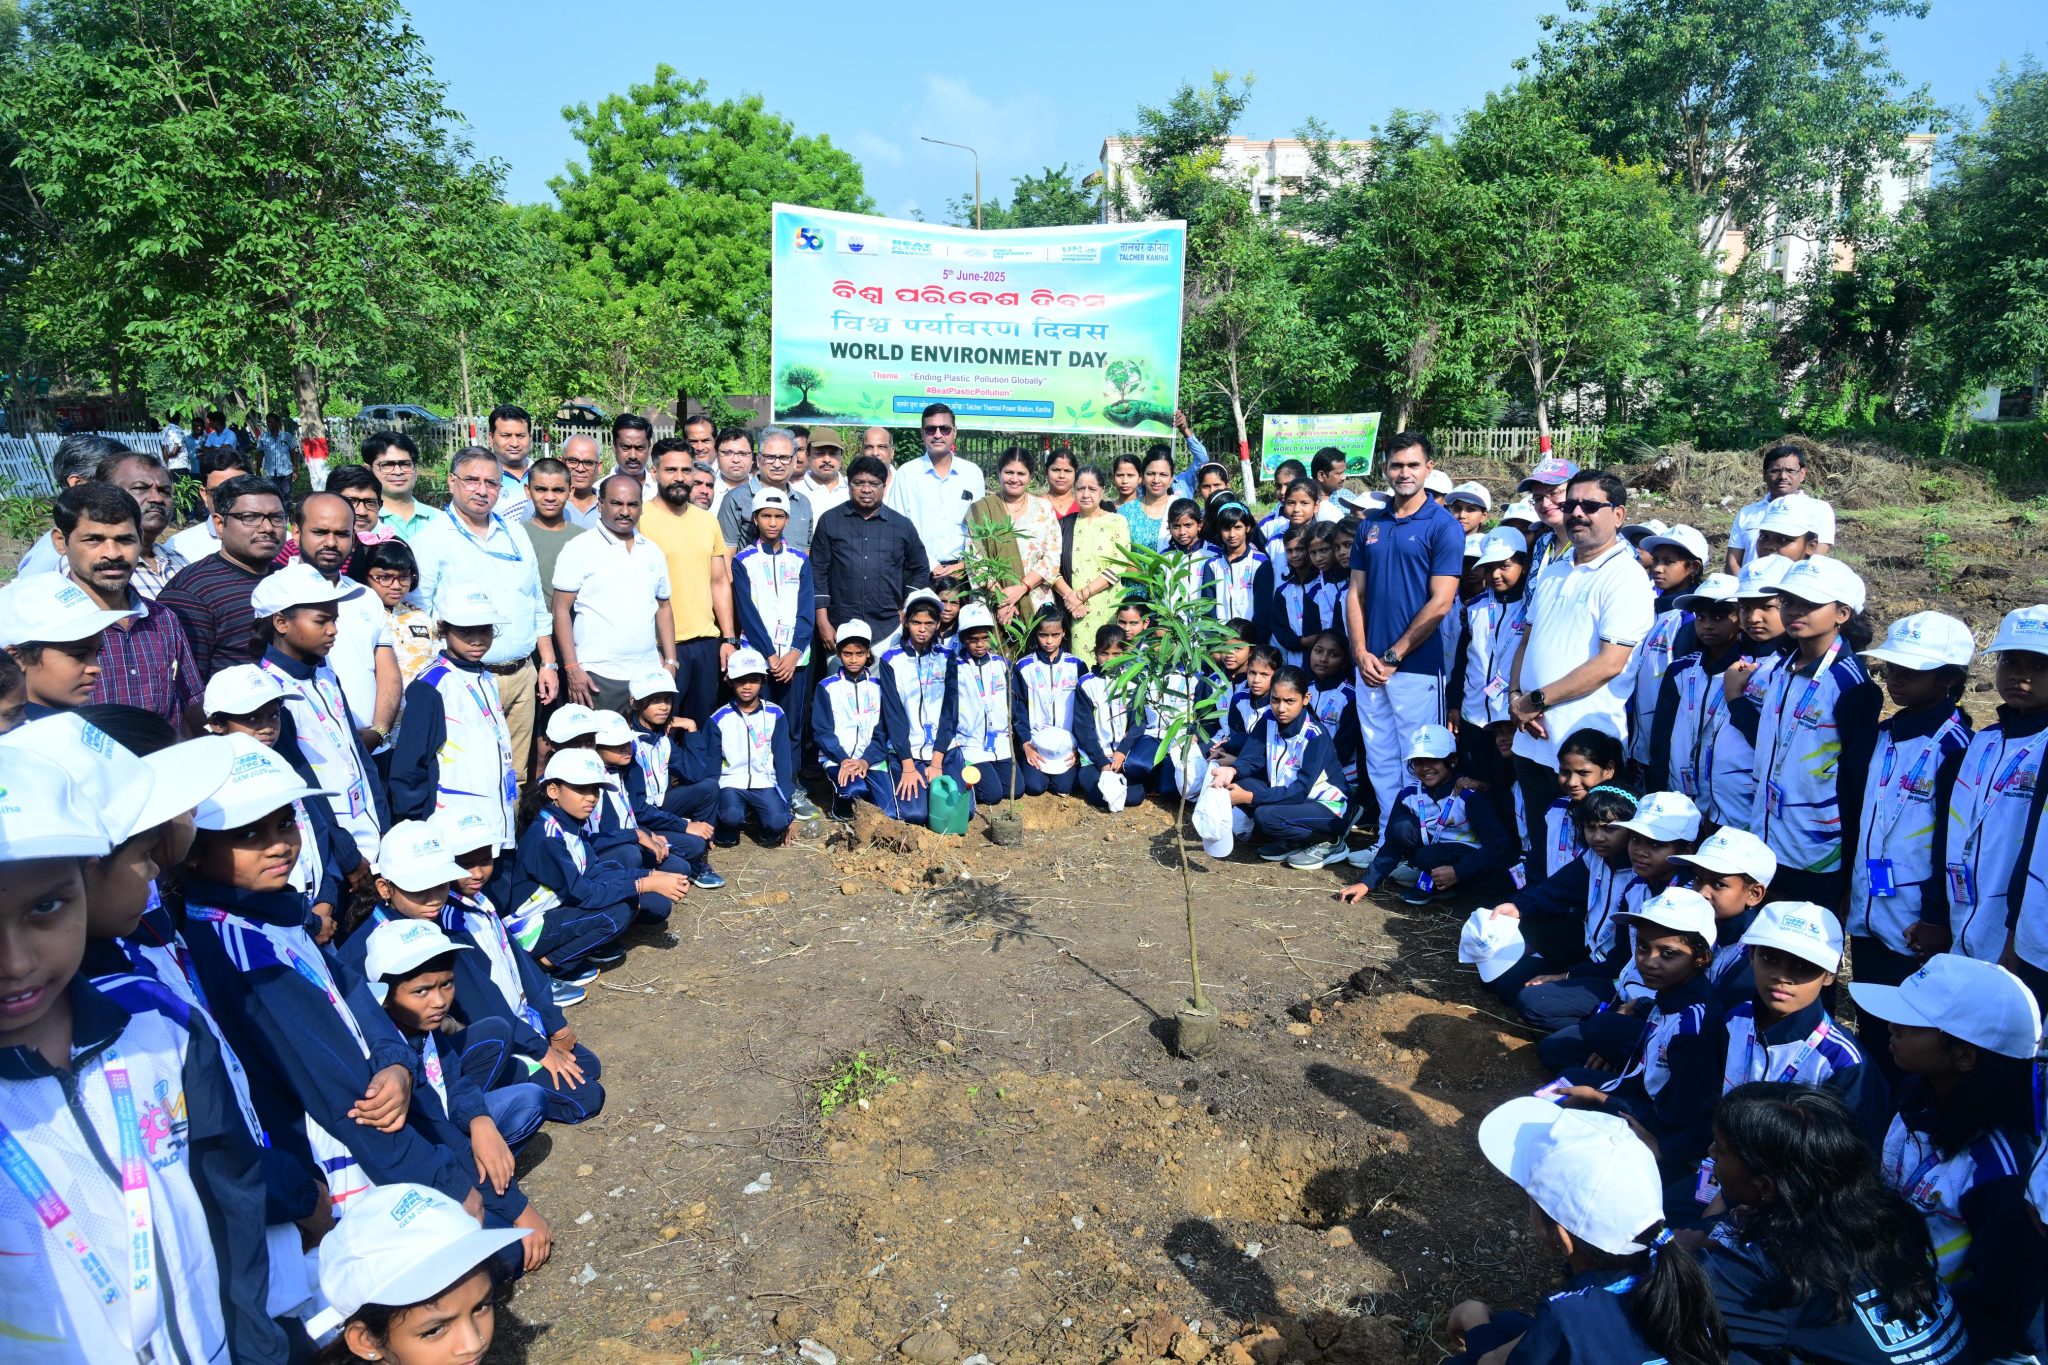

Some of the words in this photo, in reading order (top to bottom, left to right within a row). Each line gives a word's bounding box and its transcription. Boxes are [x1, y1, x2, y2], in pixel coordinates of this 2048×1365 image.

[1120, 239, 1145, 252] तालचेर
[1119, 253, 1144, 261] TALCHER
[957, 270, 1006, 282] June-2025
[830, 309, 892, 333] विश्व
[901, 312, 1019, 337] पर्यावरण
[1032, 316, 1109, 340] दिवस
[830, 341, 904, 361] WORLD
[911, 345, 1062, 367] ENVIRONMENT
[1068, 350, 1108, 368] DAY
[944, 373, 970, 382] Plastic
[975, 375, 1009, 384] Pollution
[399, 1212, 417, 1229] GEM
